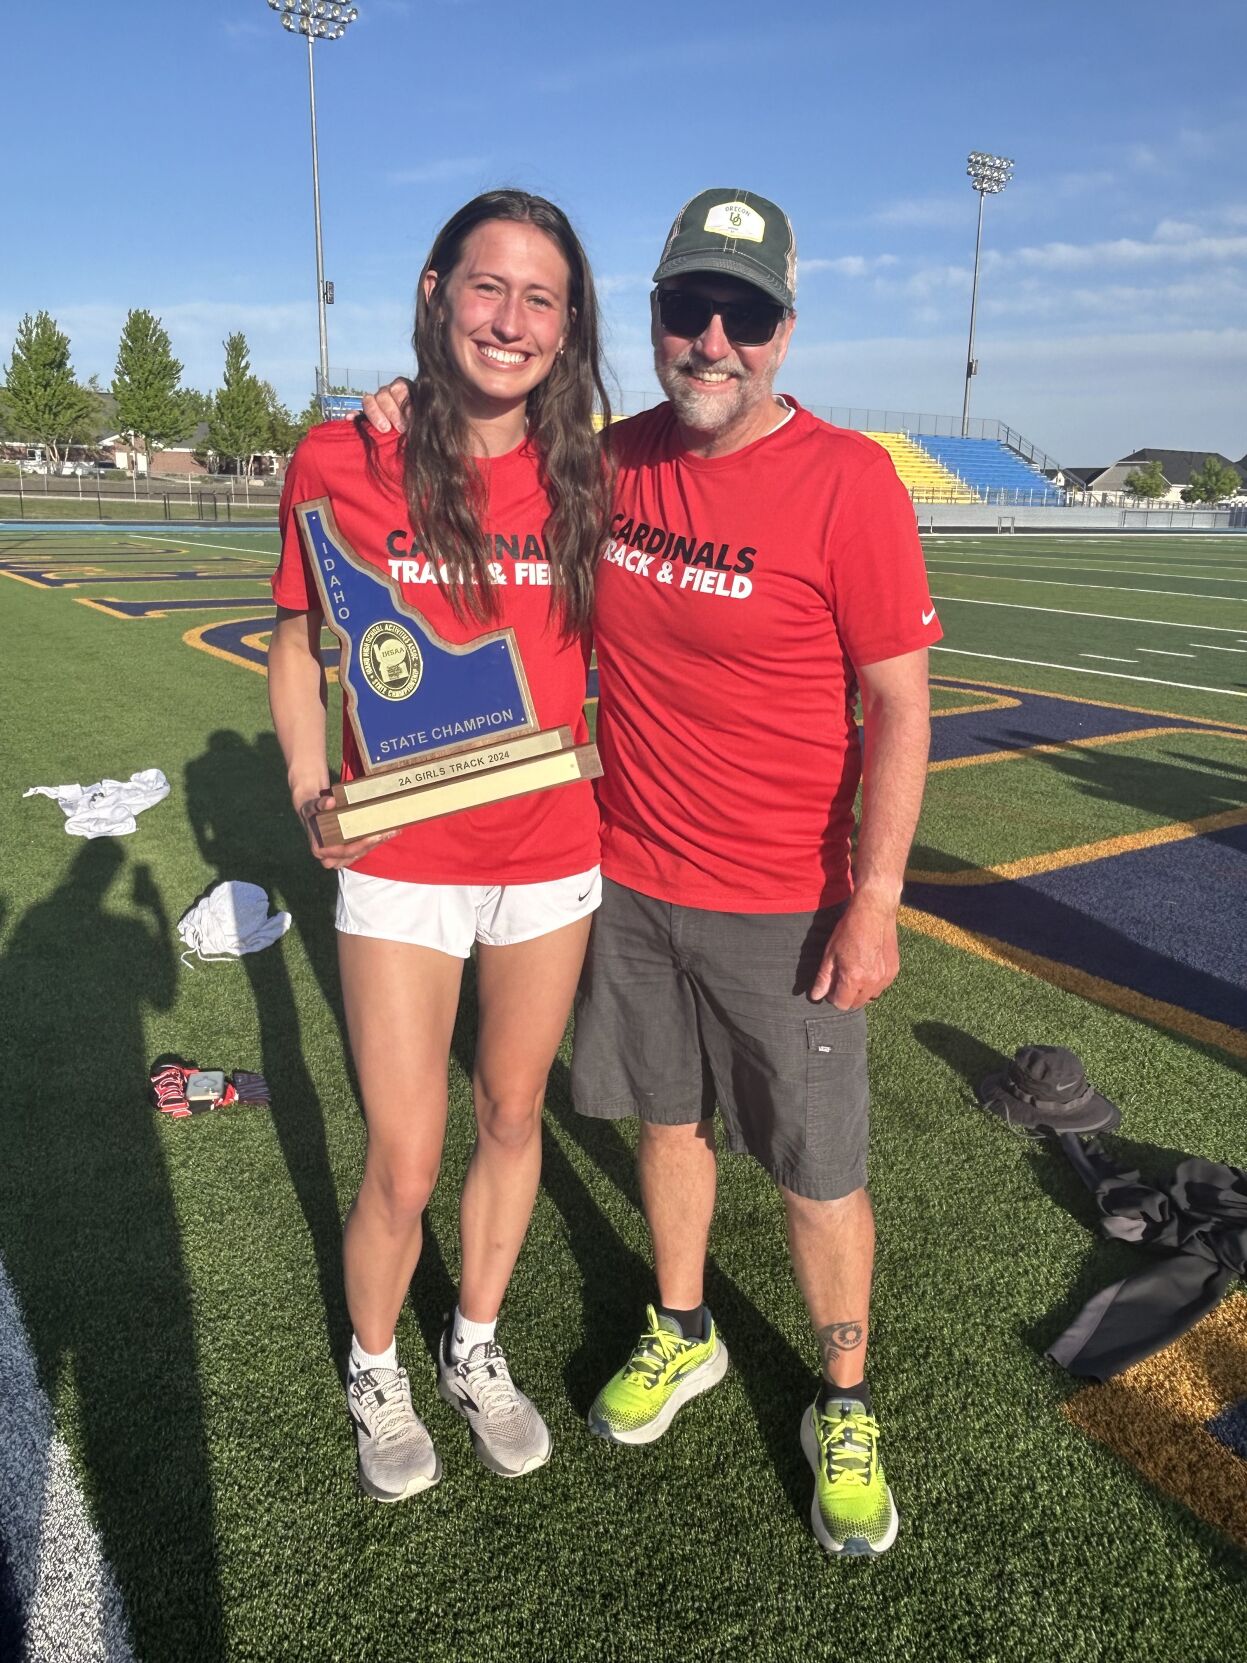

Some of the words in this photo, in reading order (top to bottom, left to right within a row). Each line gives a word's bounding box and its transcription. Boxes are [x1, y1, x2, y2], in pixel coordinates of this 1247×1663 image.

[725, 206, 751, 216] OREGON
[610, 513, 757, 574] CARDINALS
[322, 542, 350, 620] IDAHO
[488, 562, 508, 585] &
[603, 538, 656, 577] RACK
[656, 561, 674, 585] &
[679, 566, 753, 600] FIELD
[382, 647, 405, 658] IHSAA
[380, 731, 428, 753] STATE
[431, 708, 513, 740] CHAMPION
[398, 776, 412, 787] 2A
[415, 767, 446, 782] GIRLS
[449, 757, 485, 774] TRACK
[487, 750, 510, 763] 2024
